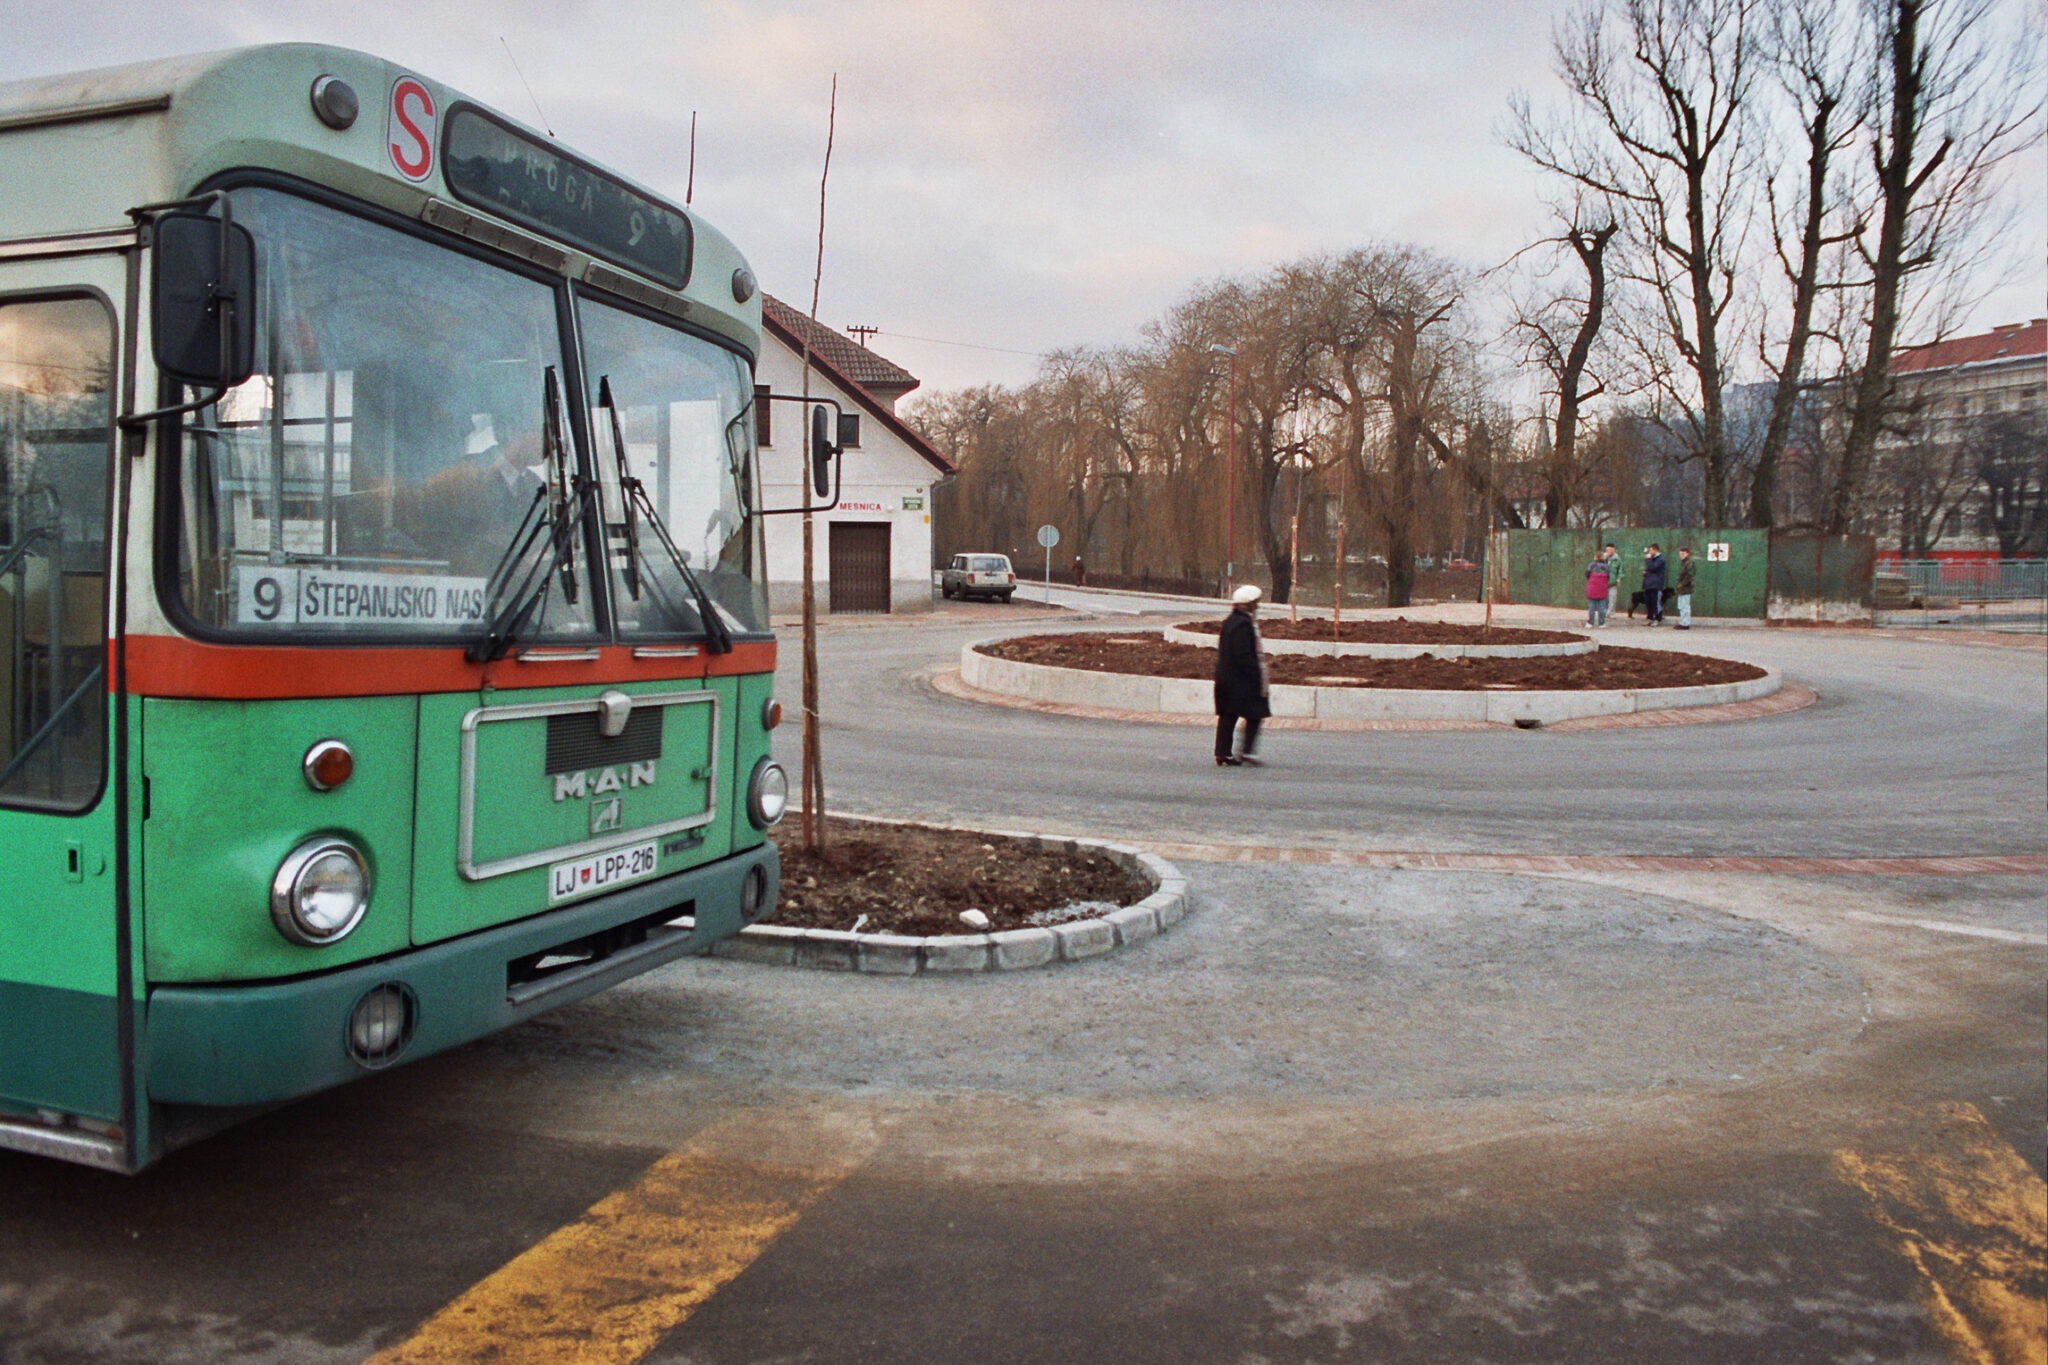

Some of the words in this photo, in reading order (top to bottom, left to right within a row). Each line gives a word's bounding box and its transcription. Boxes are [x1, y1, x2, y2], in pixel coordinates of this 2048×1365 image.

[391, 80, 434, 178] S
[628, 210, 646, 246] 9
[839, 502, 882, 512] MESNICA
[253, 577, 283, 621] 9
[304, 576, 437, 619] ŠTEPANJSKO
[556, 867, 576, 896] LJ
[595, 846, 654, 885] LPP-216
